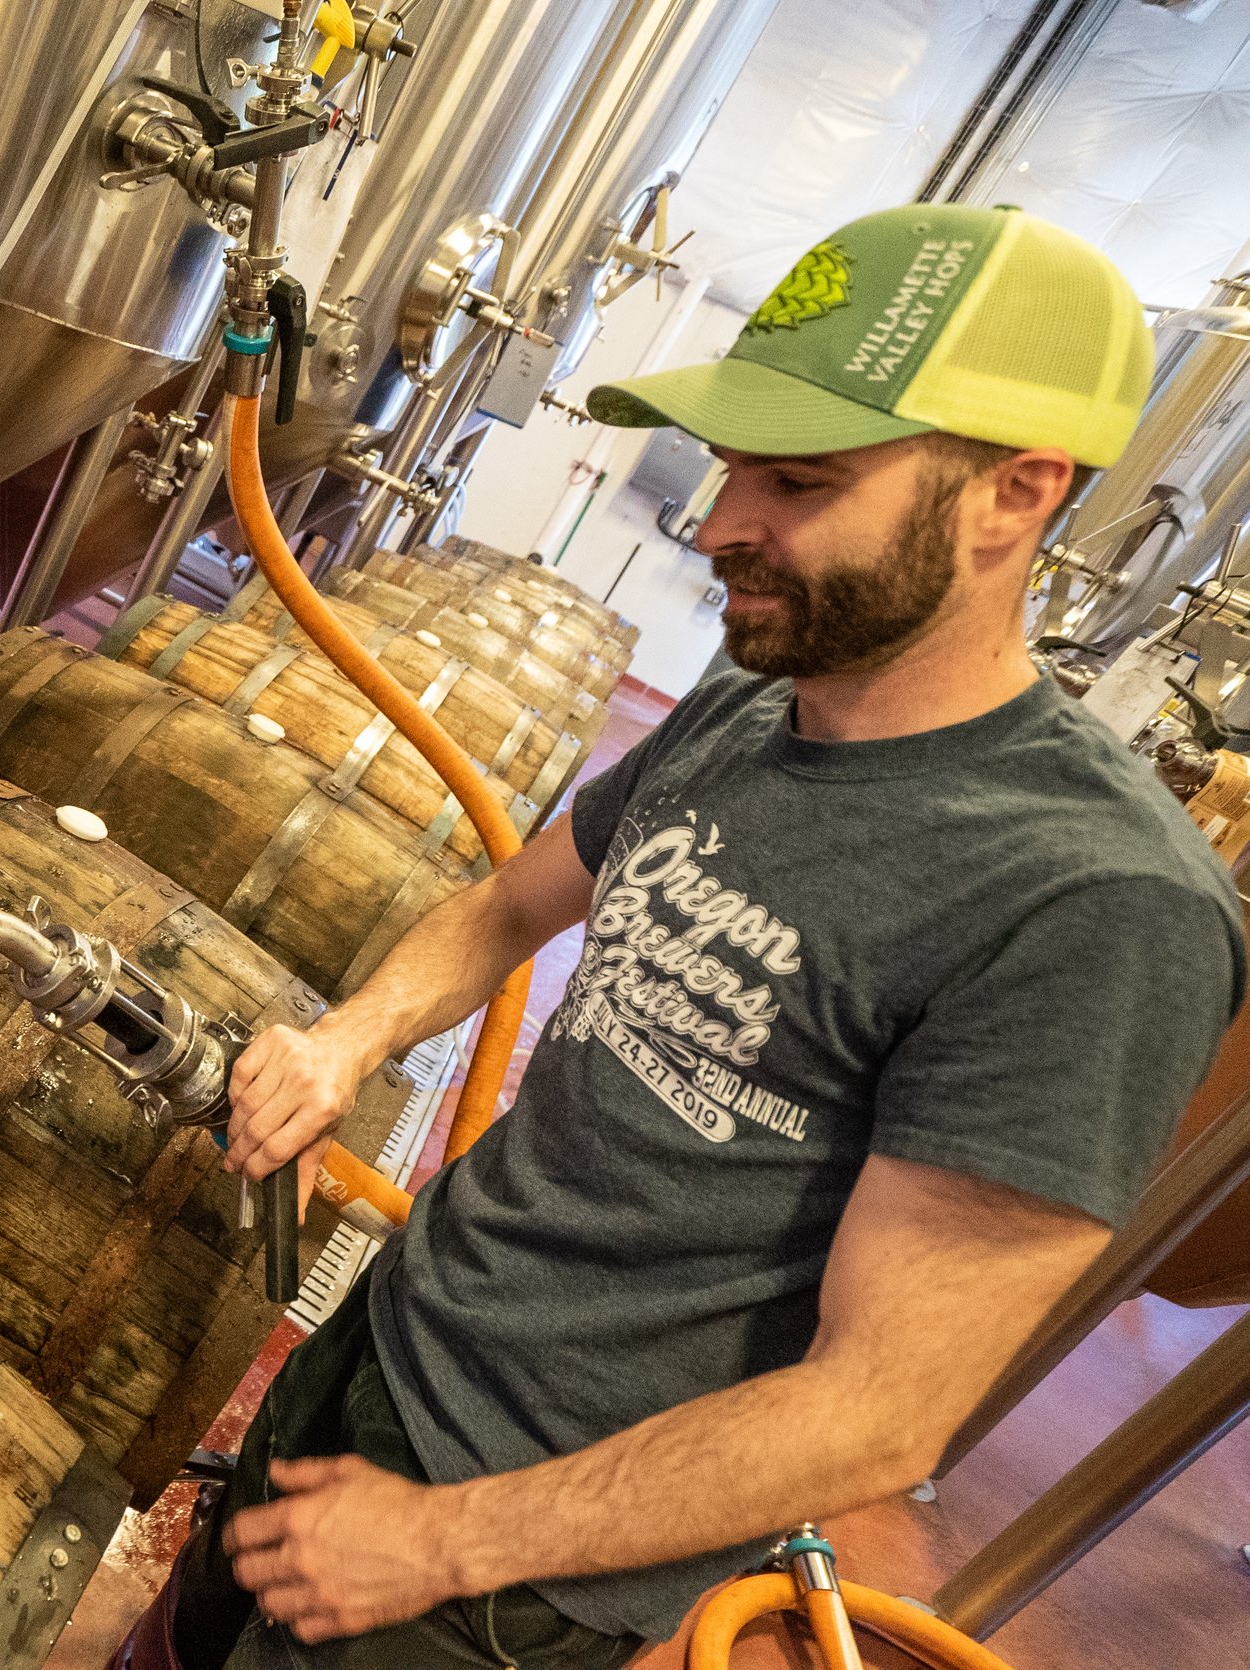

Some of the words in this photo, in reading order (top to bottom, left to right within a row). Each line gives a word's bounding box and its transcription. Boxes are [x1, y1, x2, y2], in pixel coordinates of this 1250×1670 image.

[846, 241, 946, 371] WILLAMETTE
[867, 302, 933, 381] VALLEY
[925, 241, 973, 296] HOPS
[594, 886, 780, 1023] Brewers
[624, 826, 801, 974] Oregon
[589, 945, 770, 1064] Festival
[594, 1000, 617, 1037] JULY
[619, 1033, 669, 1085] 24-27
[670, 1079, 719, 1130] 2019
[694, 1058, 742, 1106] 32ND
[733, 1083, 809, 1142] ANNUAL
